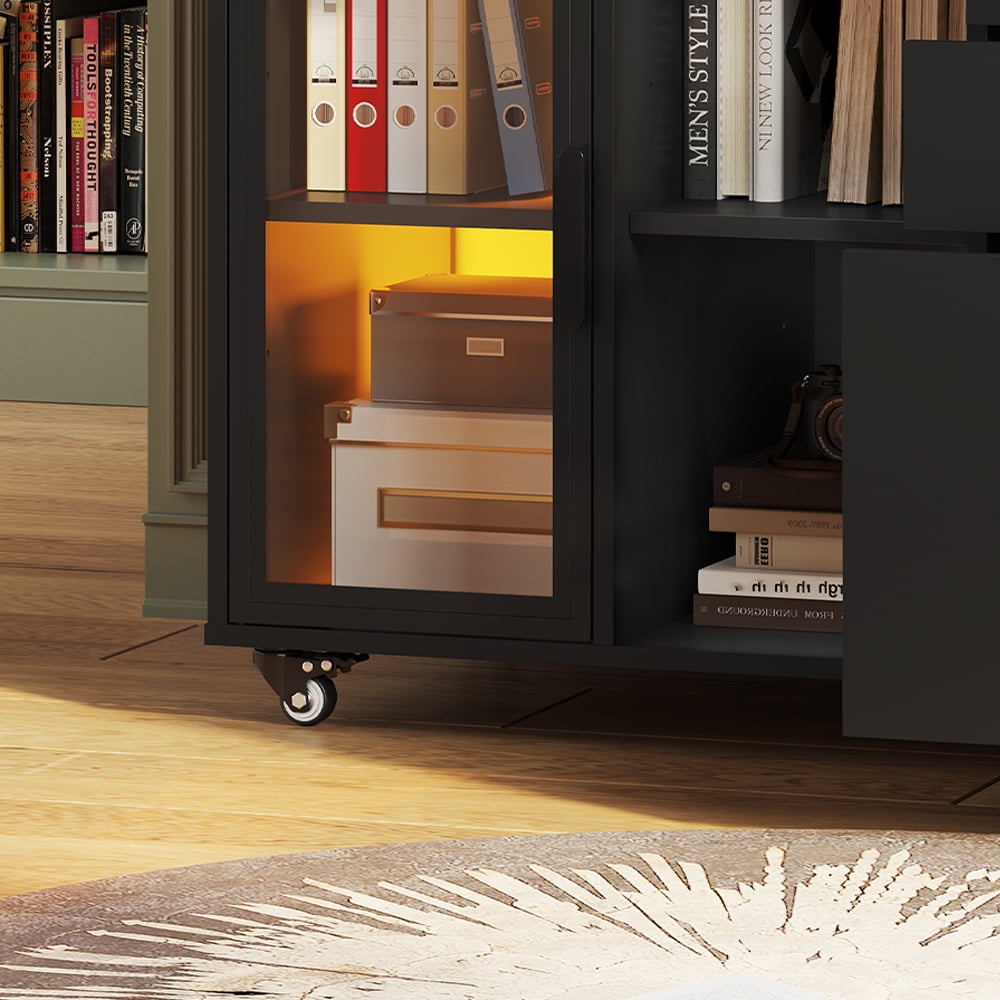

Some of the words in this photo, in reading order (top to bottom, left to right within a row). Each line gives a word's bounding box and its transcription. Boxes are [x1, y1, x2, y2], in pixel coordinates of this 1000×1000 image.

[123, 24, 131, 34] in
[123, 35, 132, 51] the
[136, 25, 144, 33] A
[688, 4, 710, 83] STYLE
[758, 23, 773, 77] LOOK
[135, 34, 145, 70] History
[123, 51, 133, 98] Twentieth
[136, 71, 144, 80] of
[102, 68, 113, 160] Bootstrapping
[122, 98, 132, 137] Century
[134, 81, 145, 133] Computing
[688, 90, 710, 167] MEN'S
[43, 136, 52, 178] Nelson
